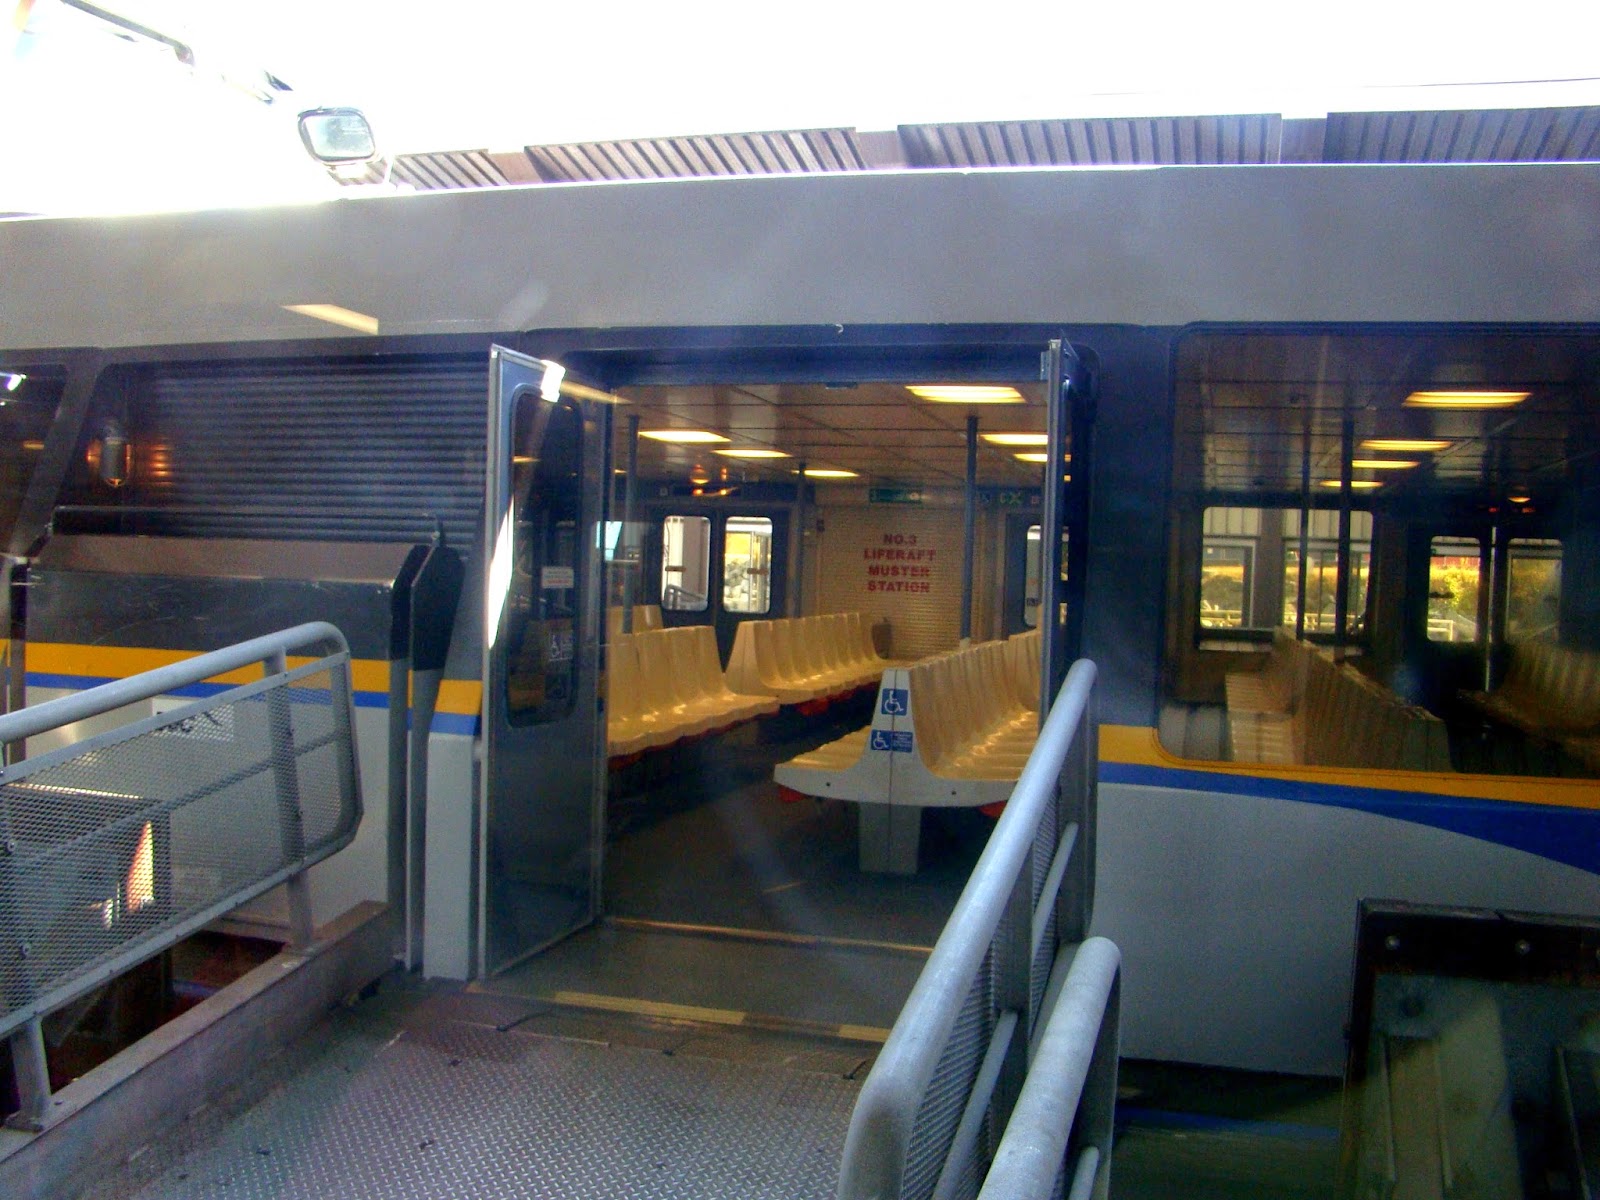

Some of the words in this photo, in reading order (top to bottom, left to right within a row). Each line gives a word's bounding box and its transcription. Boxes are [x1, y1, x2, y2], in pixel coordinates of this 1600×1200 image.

[864, 548, 936, 561] LIFERAFT
[867, 565, 929, 577] MUSTER
[867, 580, 930, 593] STATION
